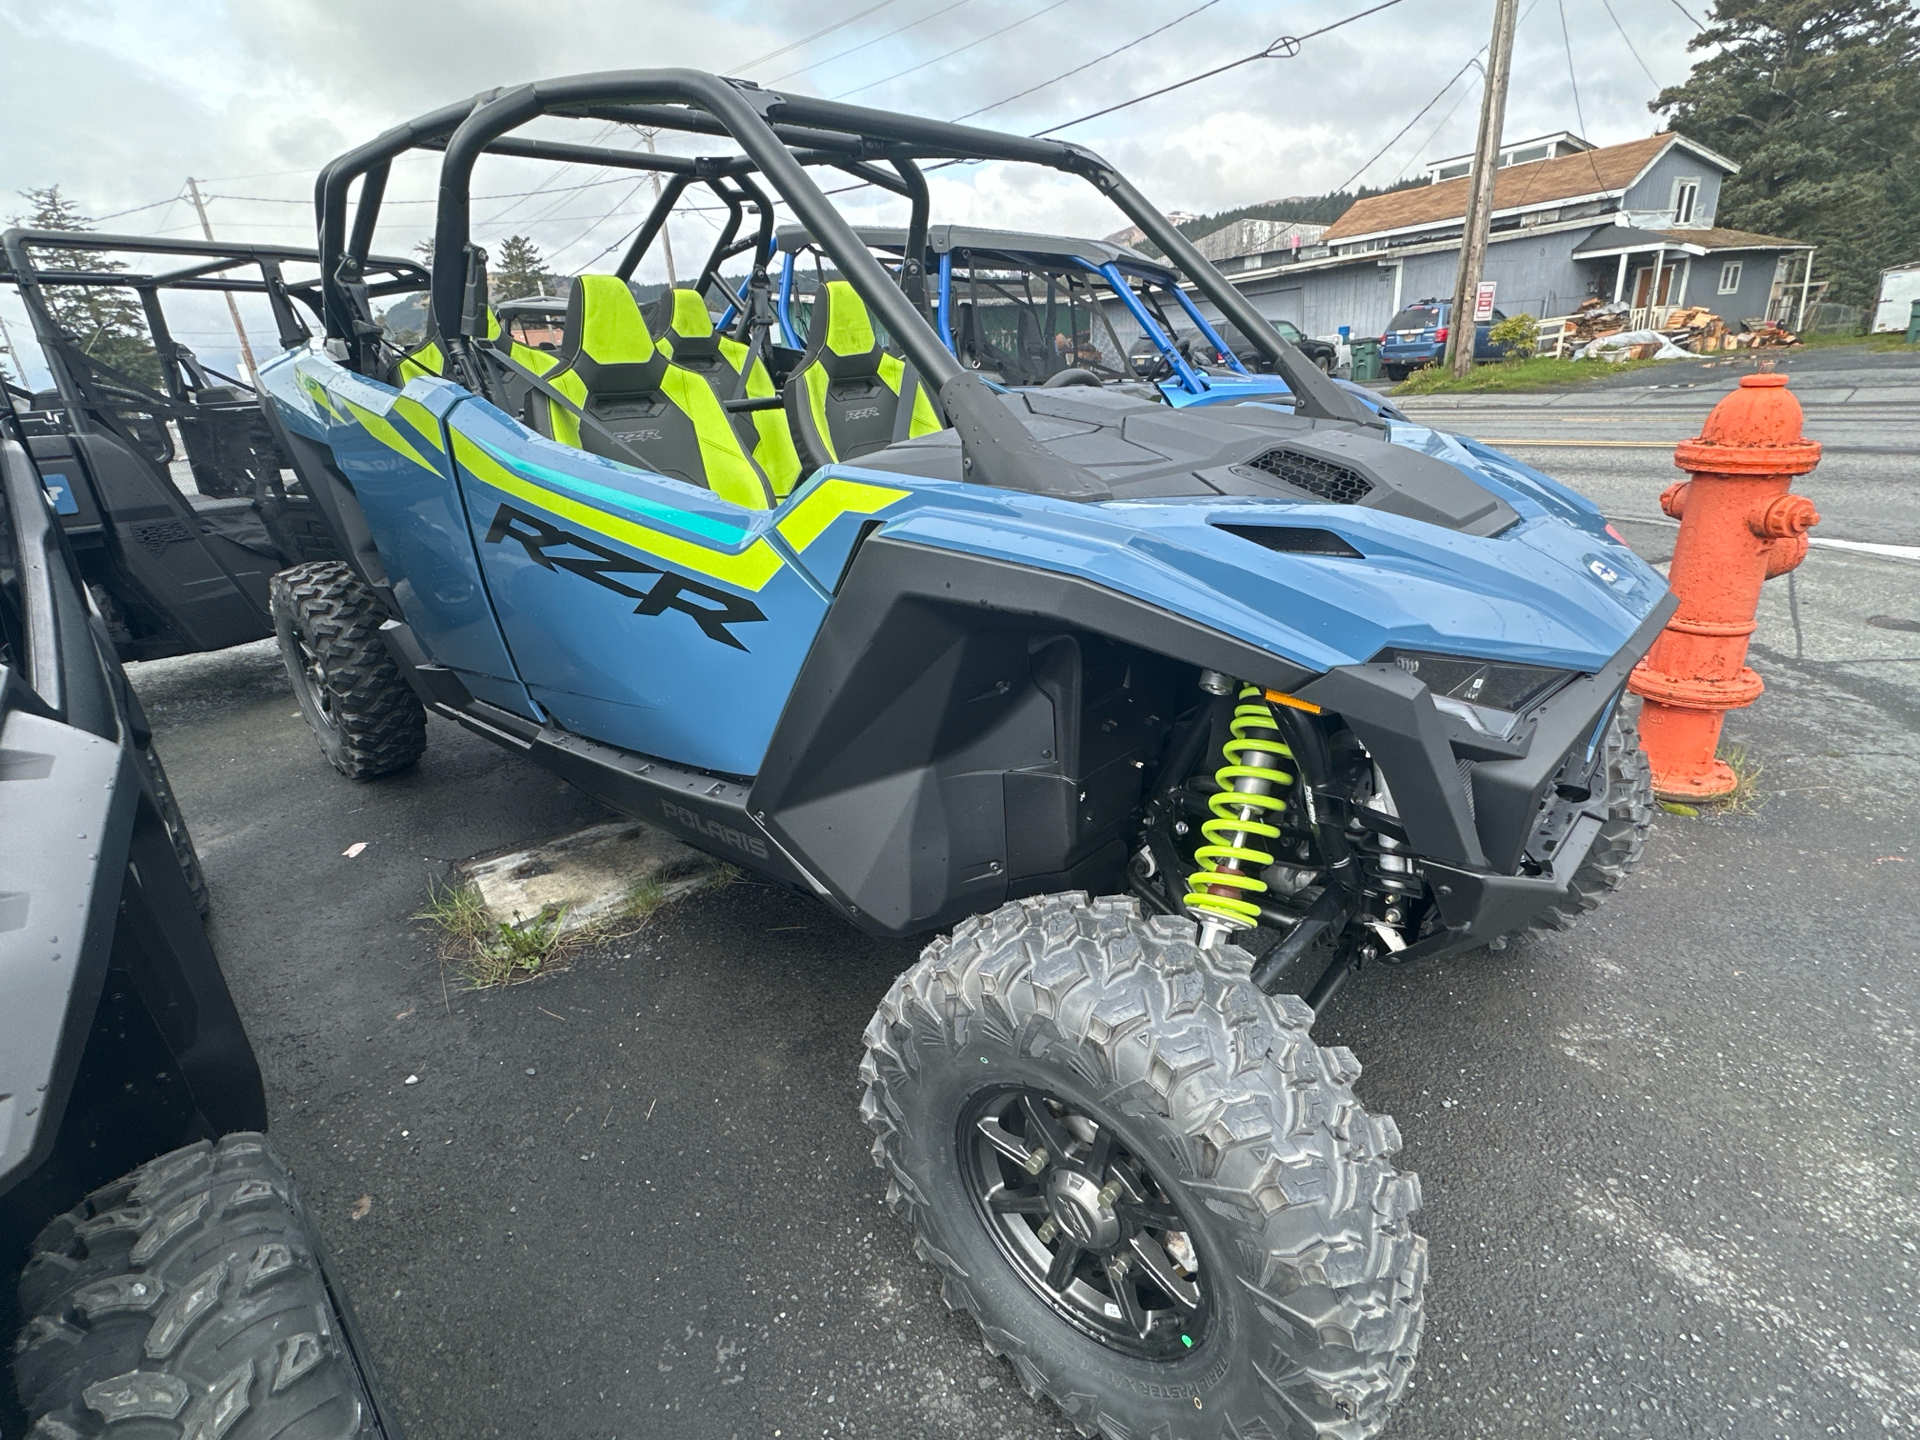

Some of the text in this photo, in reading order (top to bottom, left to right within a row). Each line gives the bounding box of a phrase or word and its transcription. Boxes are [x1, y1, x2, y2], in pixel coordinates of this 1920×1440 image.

[846, 406, 880, 421] RZR
[611, 429, 662, 444] RZR
[484, 502, 770, 654] RZR
[660, 798, 769, 860] POLARIS
[1199, 1357, 1230, 1391] TRAIL
[1140, 1381, 1201, 1399] MASTER
